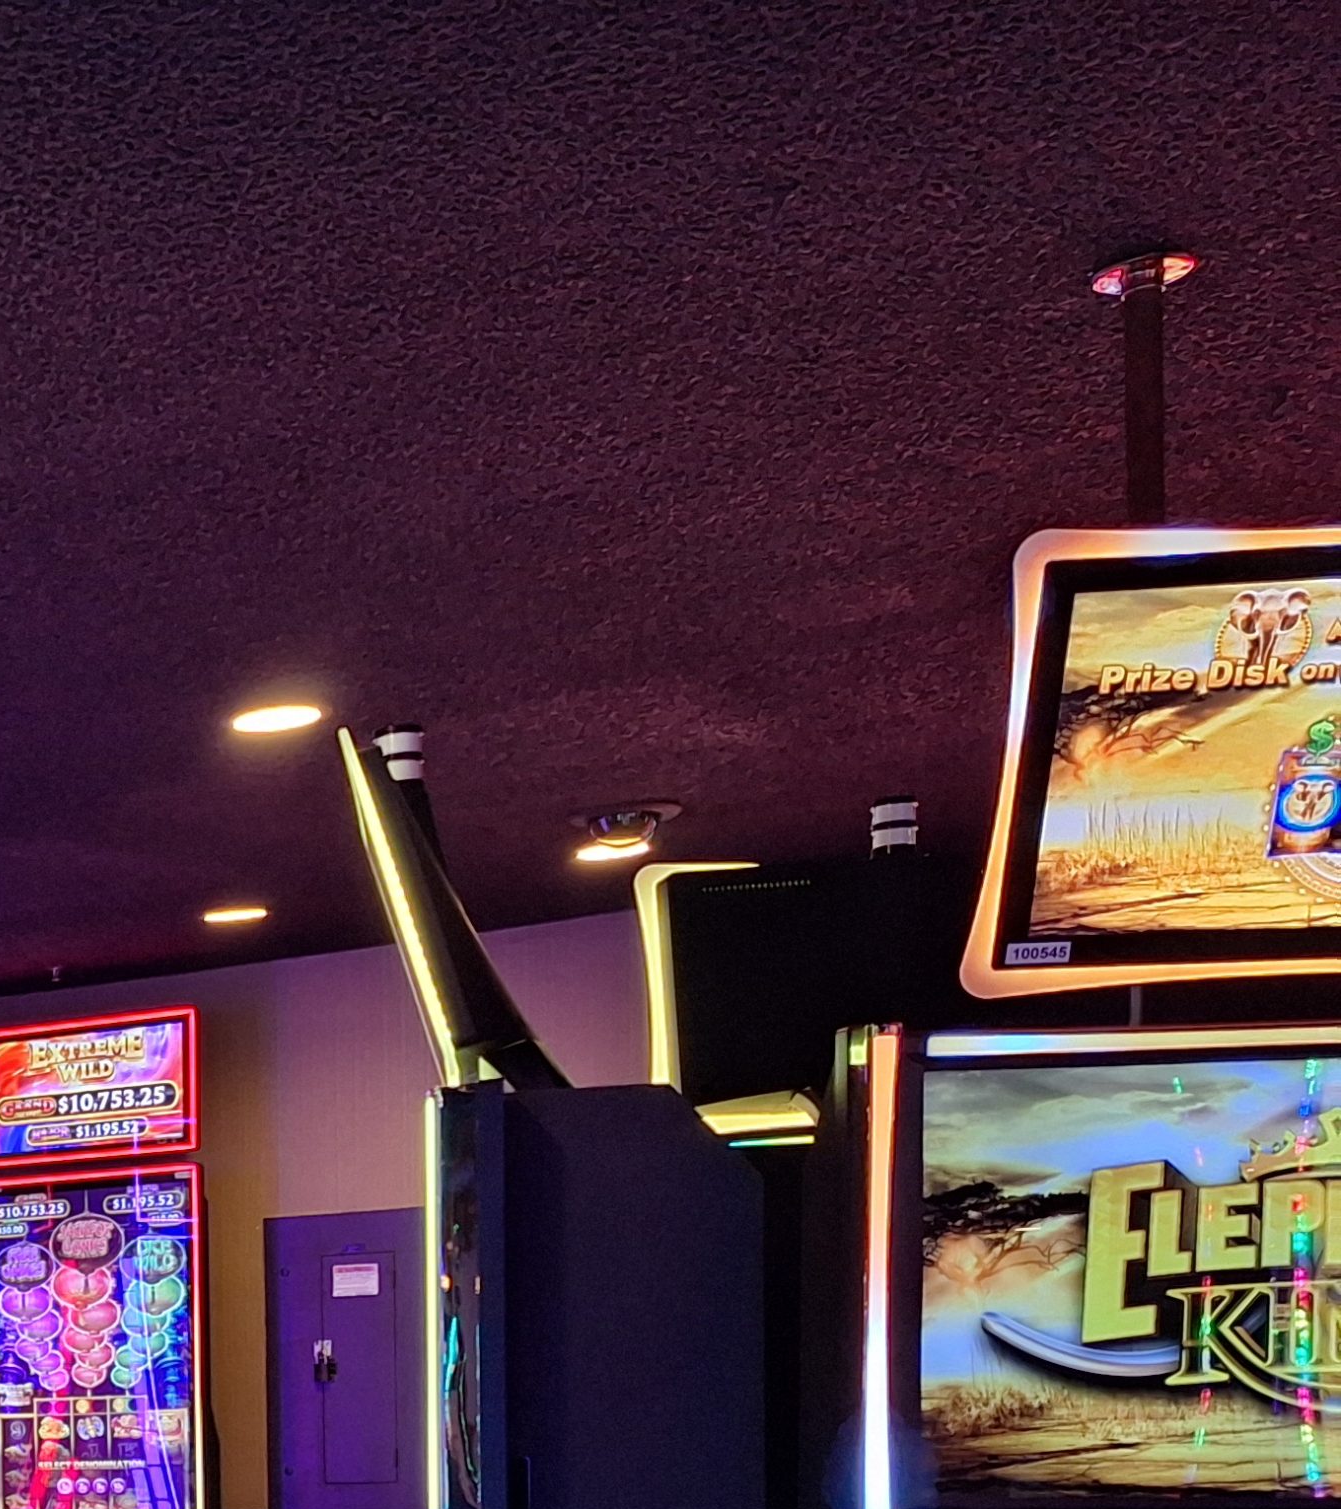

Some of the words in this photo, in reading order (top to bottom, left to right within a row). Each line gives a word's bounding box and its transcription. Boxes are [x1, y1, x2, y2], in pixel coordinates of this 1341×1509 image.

[1098, 661, 1196, 695] Prize
[1206, 655, 1290, 690] Disk
[1301, 663, 1335, 682] on
[1012, 945, 1068, 962] 100545
[28, 1029, 146, 1071] EXTREME
[58, 1059, 115, 1083] WILD
[2, 1098, 55, 1116] GRAND
[58, 1086, 166, 1115] $10,753.25
[37, 1460, 72, 1469] SELECT
[73, 1459, 146, 1469] DENOMINATION
